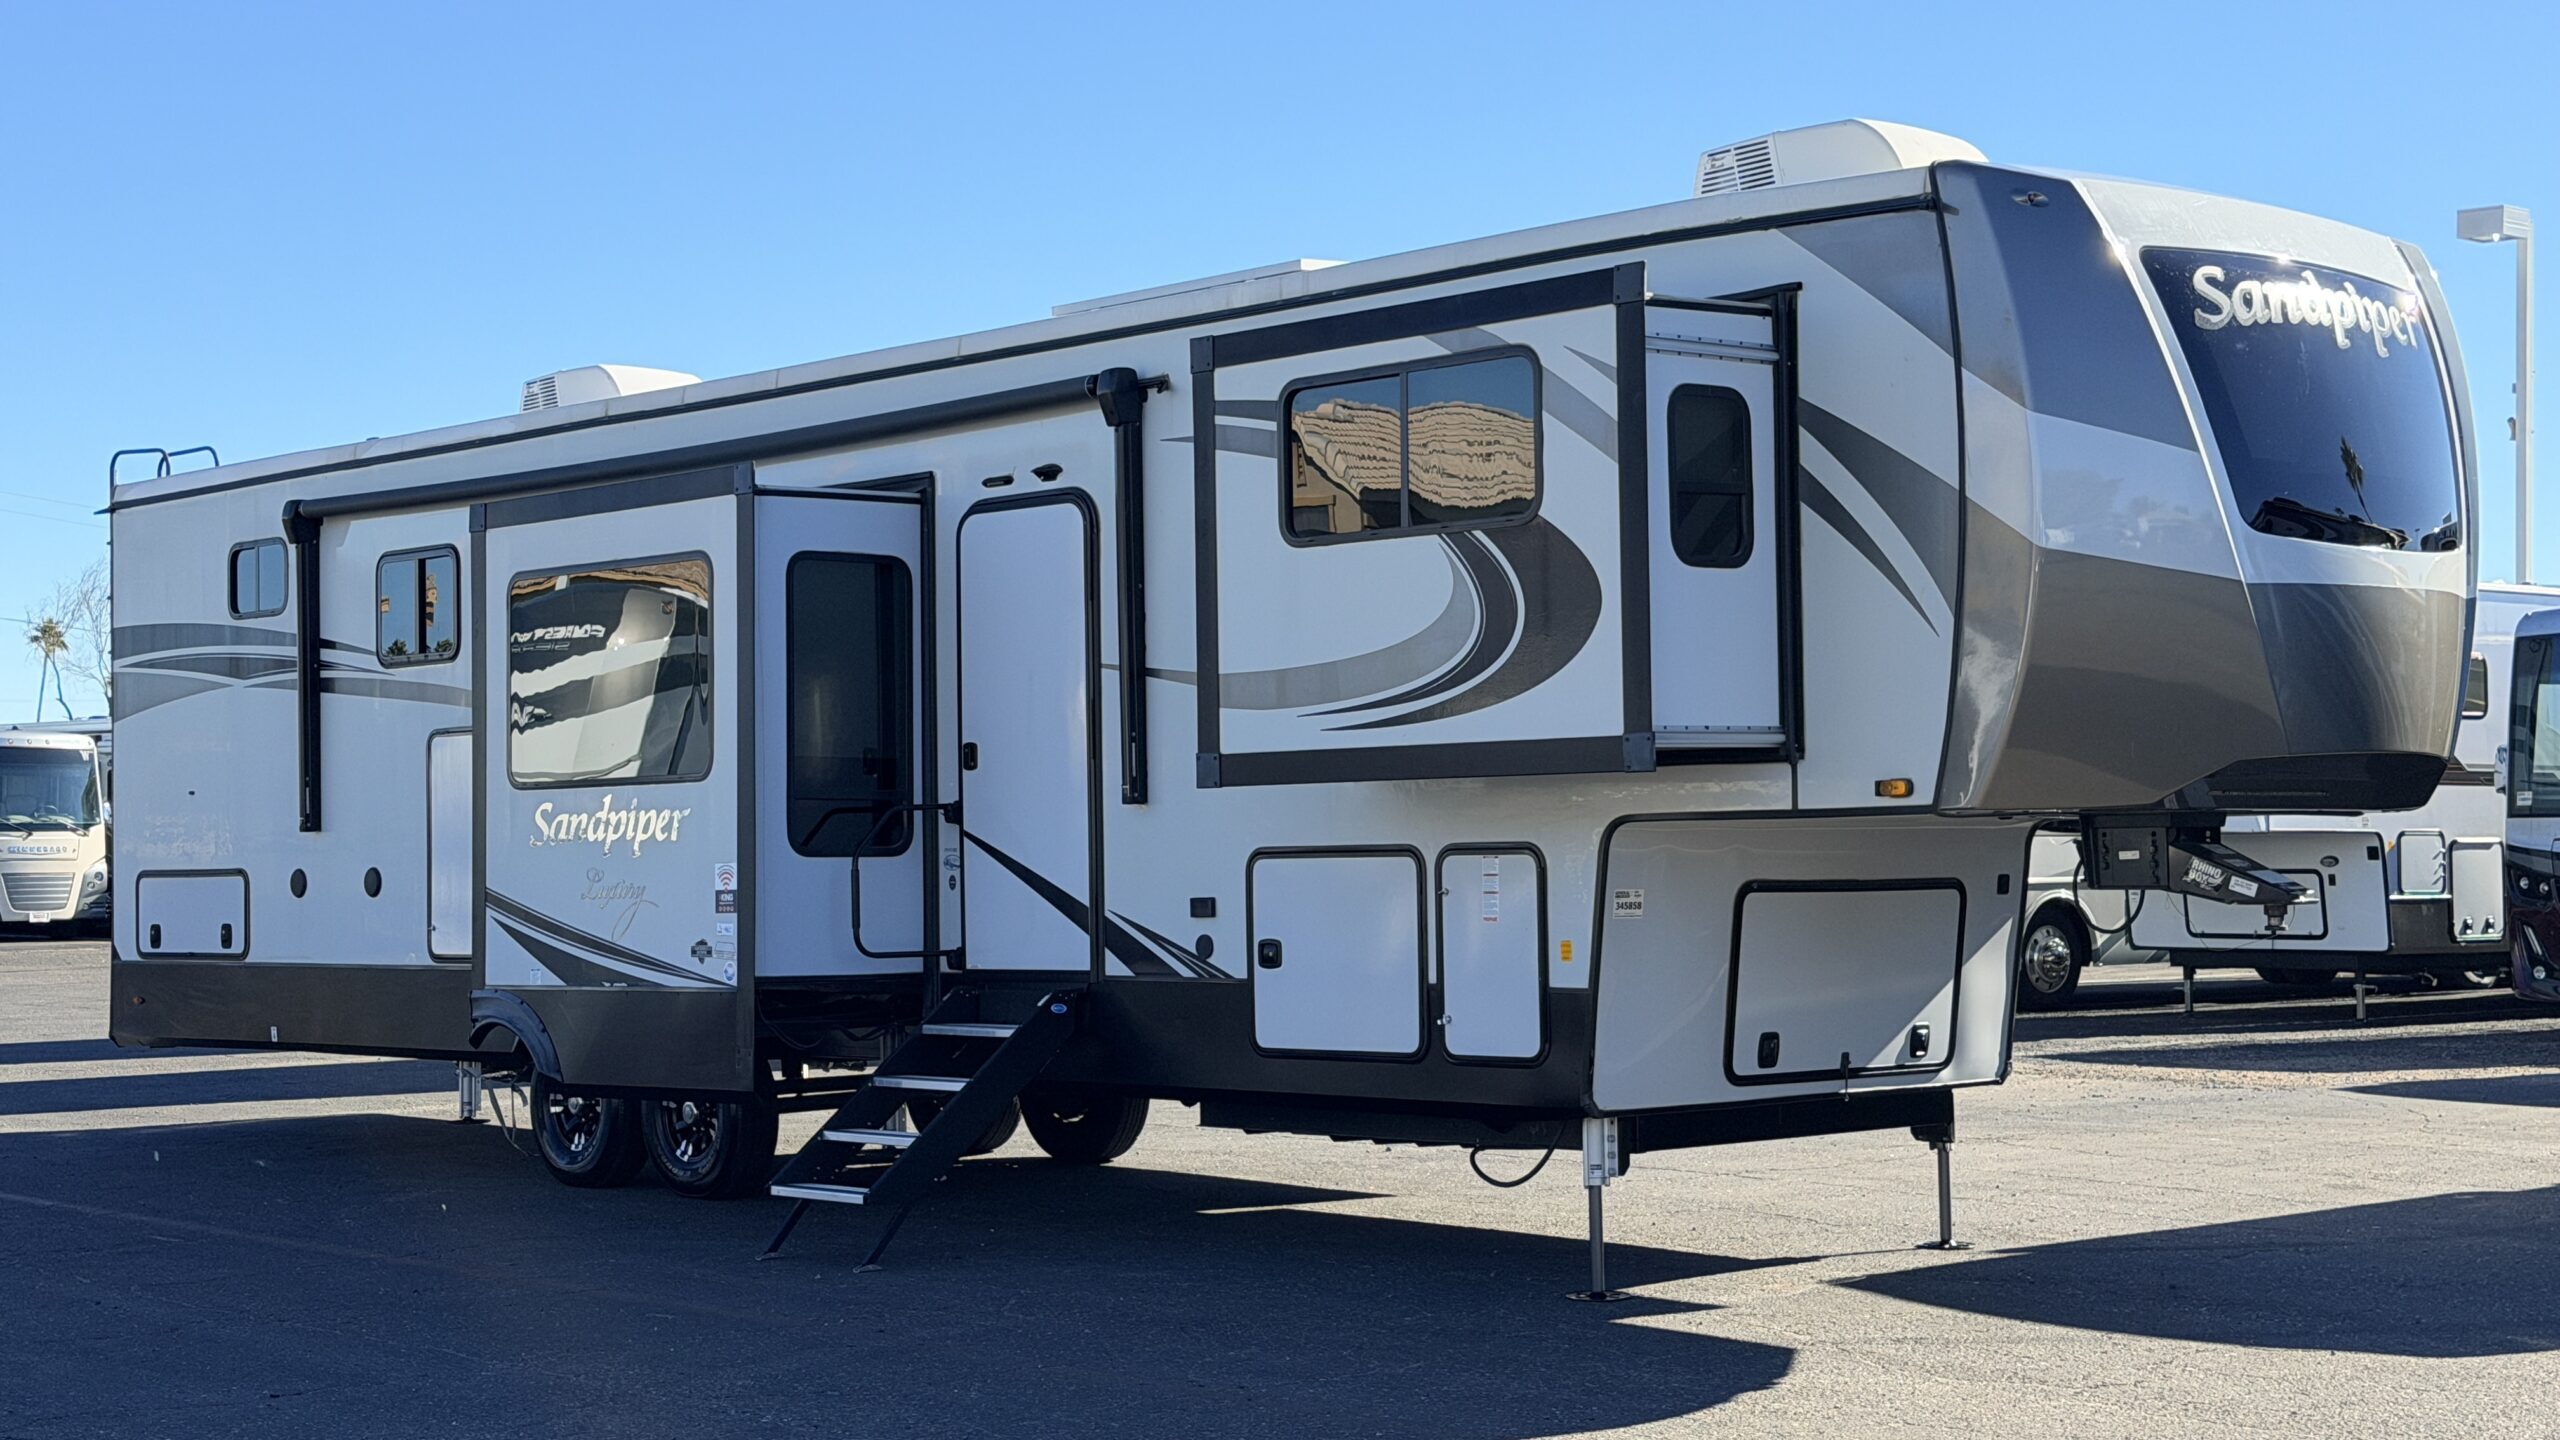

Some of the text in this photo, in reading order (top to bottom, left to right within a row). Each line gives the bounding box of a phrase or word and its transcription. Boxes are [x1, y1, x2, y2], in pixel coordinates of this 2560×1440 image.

[2193, 265, 2418, 358] Sandpiper
[529, 793, 692, 858] Sandpiper
[2187, 868, 2210, 884] BOX
[2191, 859, 2223, 879] RHINO
